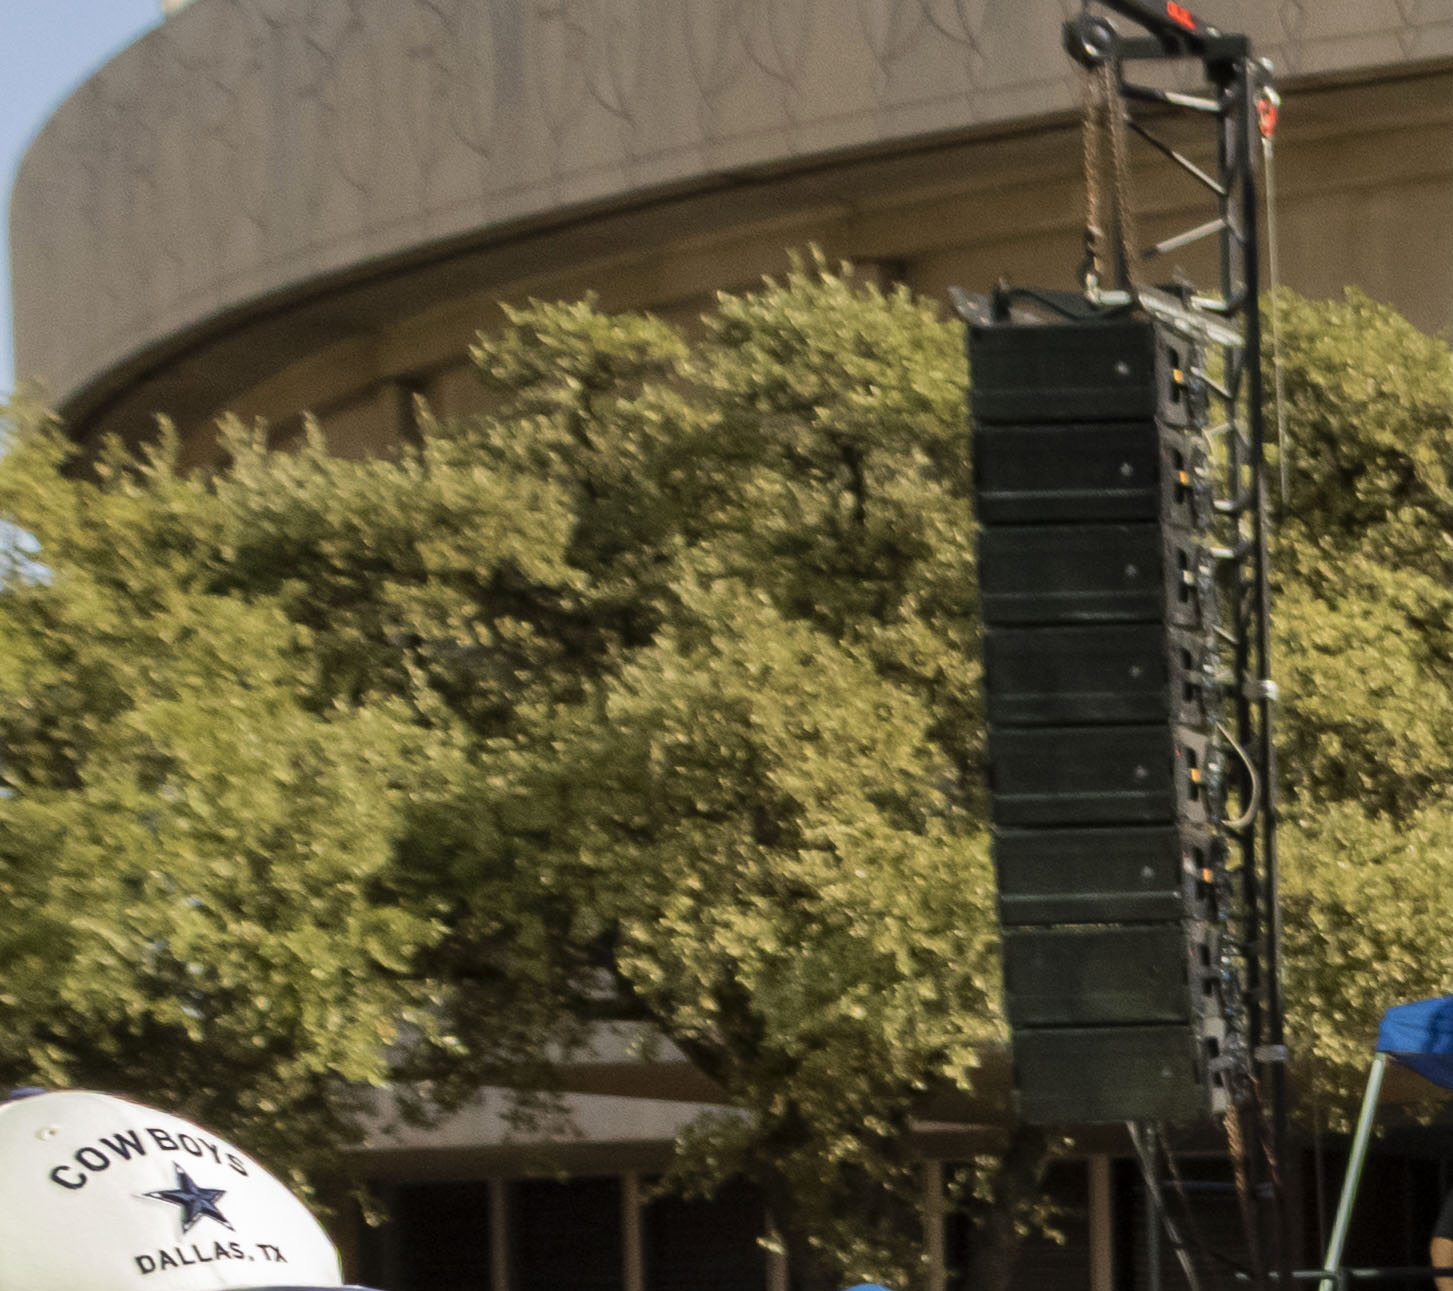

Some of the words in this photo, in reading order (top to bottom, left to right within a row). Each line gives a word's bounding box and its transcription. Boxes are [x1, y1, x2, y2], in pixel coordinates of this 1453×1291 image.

[50, 1128, 248, 1190] COWBOYS
[135, 1240, 255, 1275] DALLAS,
[255, 1243, 288, 1263] TX
